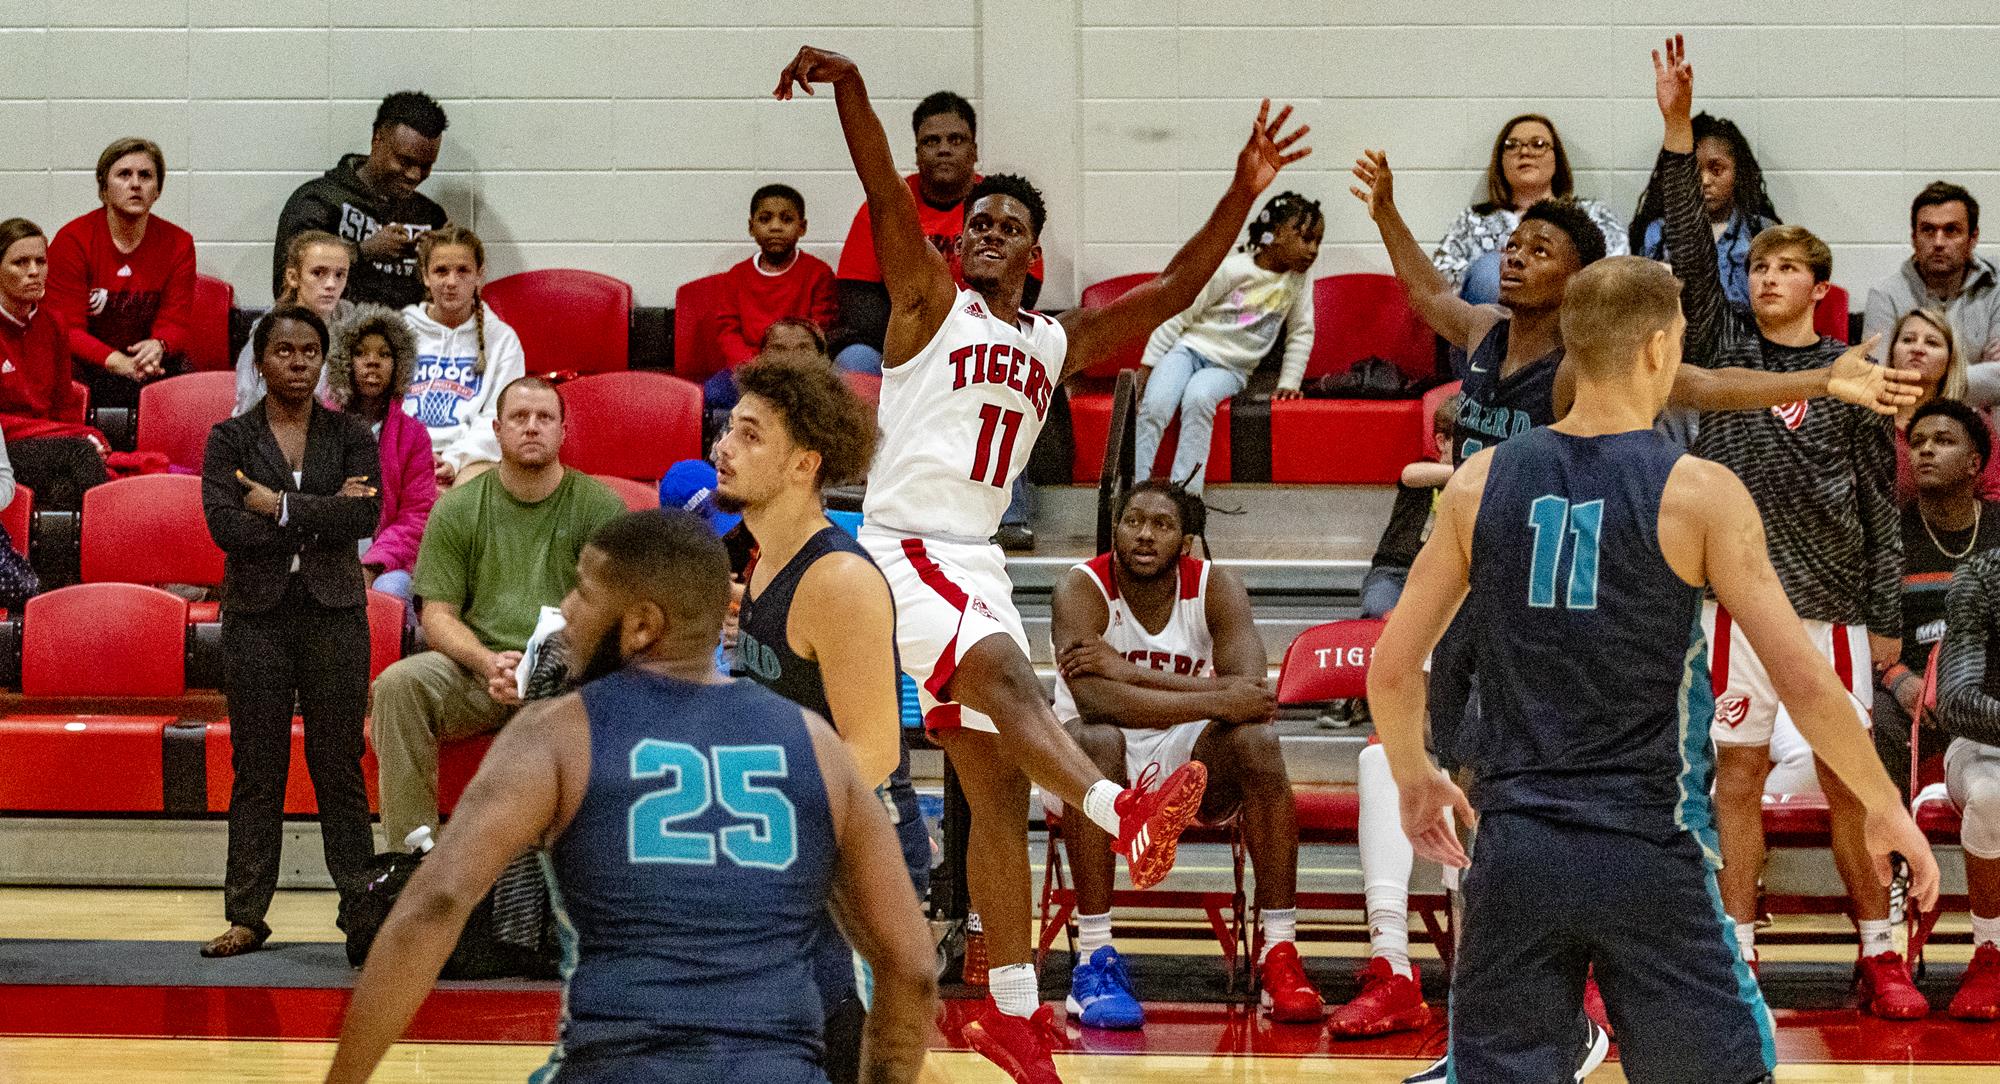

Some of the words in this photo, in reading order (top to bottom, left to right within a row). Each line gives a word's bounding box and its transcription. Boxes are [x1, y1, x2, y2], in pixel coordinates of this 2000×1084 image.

[949, 343, 1053, 422] TIGERS
[970, 403, 1025, 488] 11
[1528, 494, 1604, 610] 11
[628, 738, 798, 871] 25
